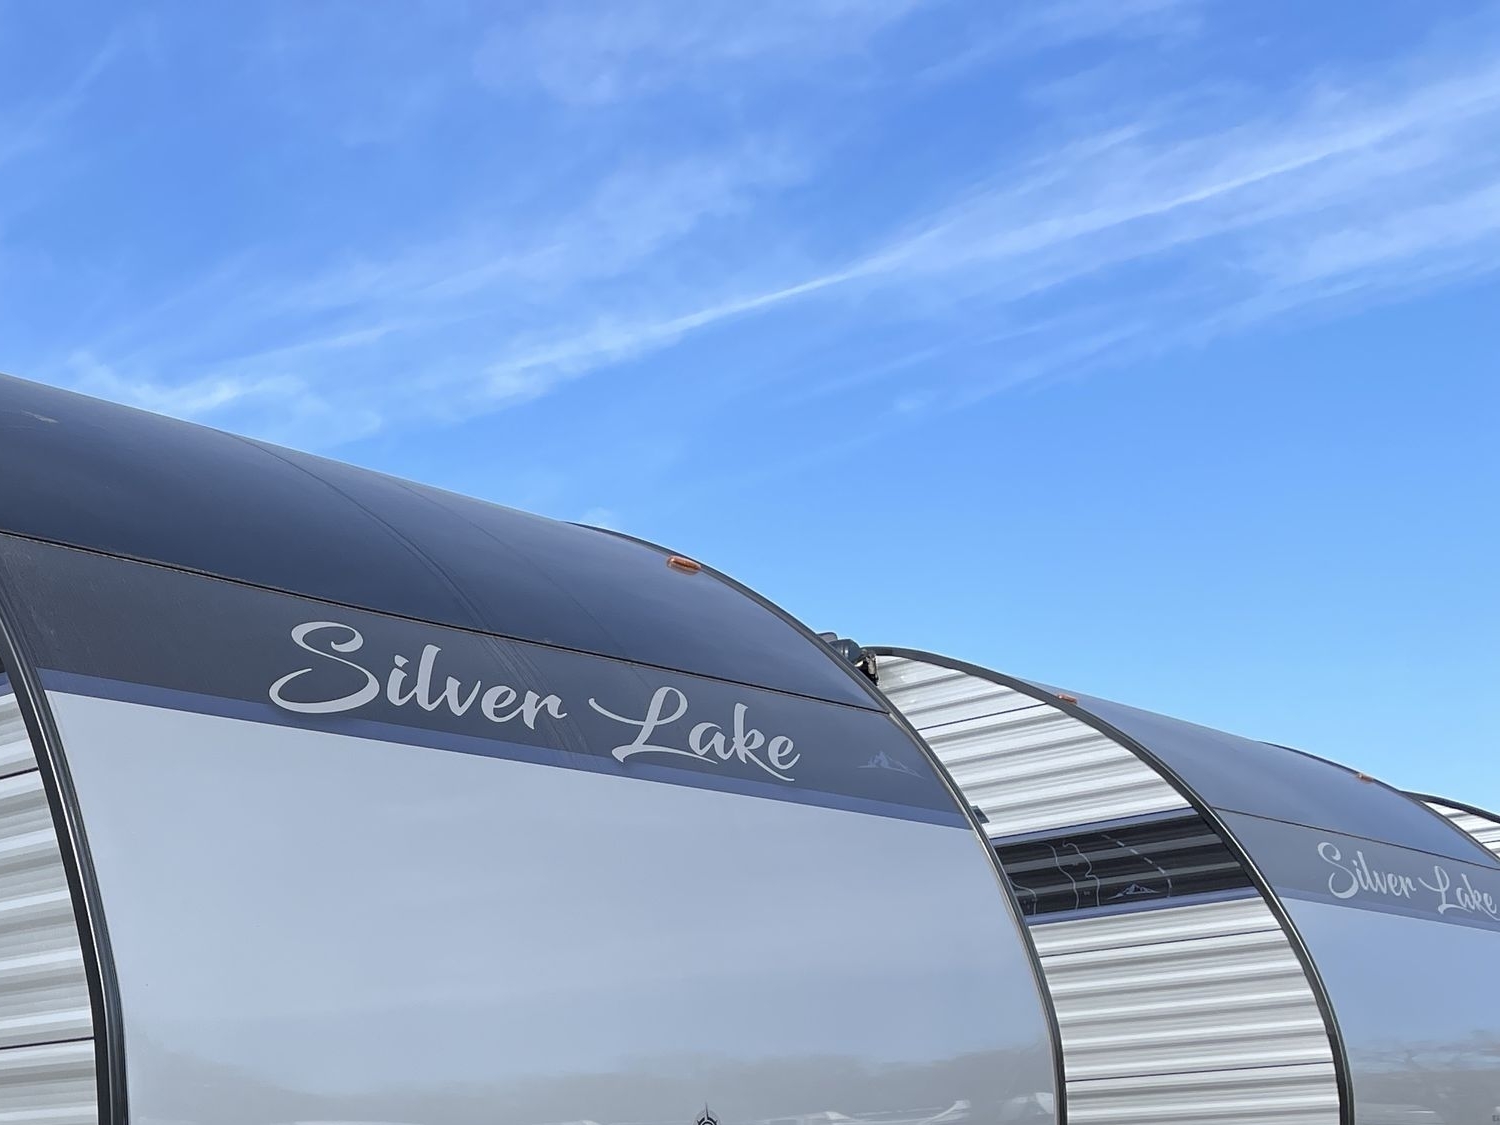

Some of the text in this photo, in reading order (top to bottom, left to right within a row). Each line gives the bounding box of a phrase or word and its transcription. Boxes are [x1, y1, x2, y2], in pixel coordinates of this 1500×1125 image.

[268, 621, 801, 781] Silver Lake
[1317, 842, 1500, 921] Silver Lake
